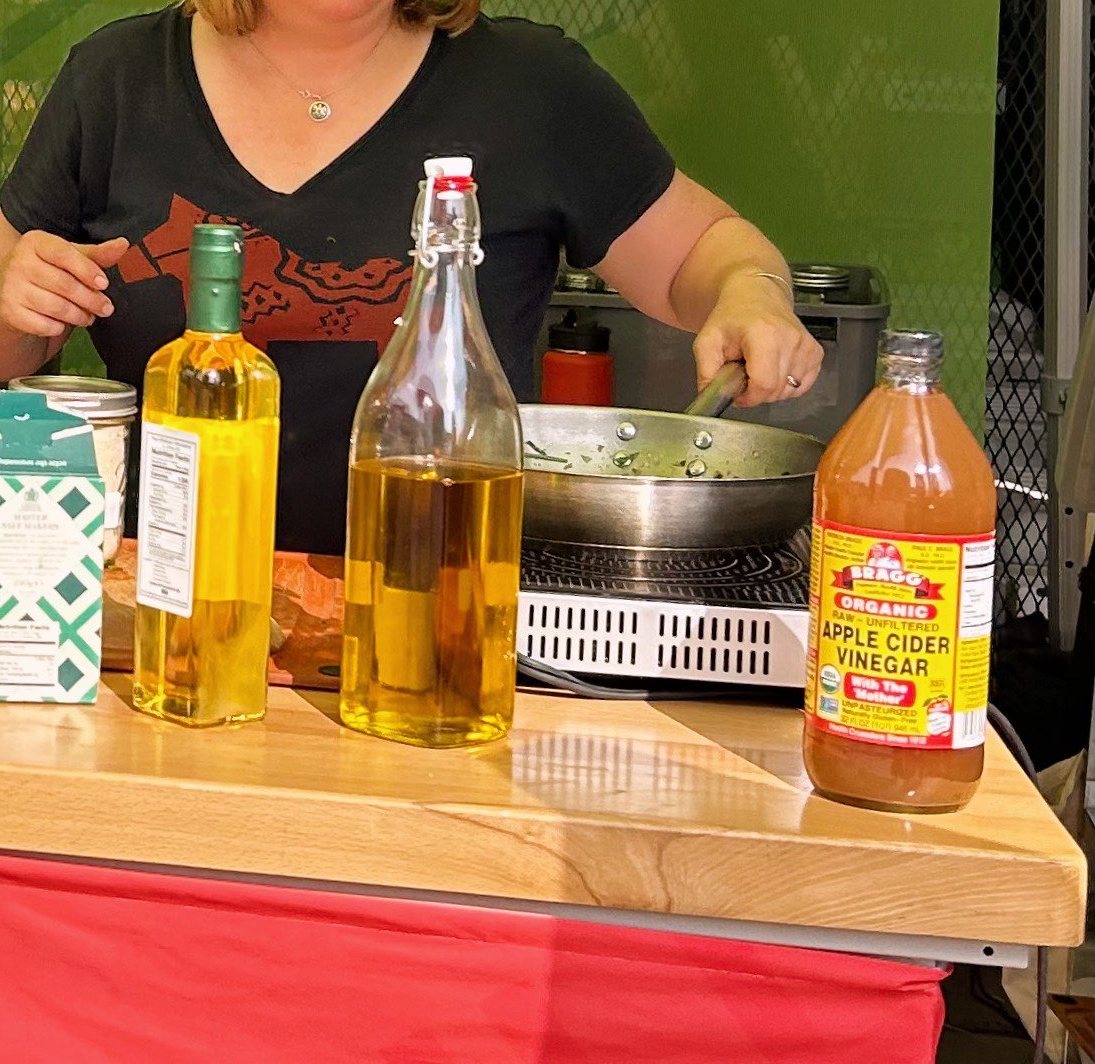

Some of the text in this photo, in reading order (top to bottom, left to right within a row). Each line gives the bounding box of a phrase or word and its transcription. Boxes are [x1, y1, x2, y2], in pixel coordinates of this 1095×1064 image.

[850, 565, 923, 586] BRAGG
[840, 595, 929, 618] ORGANIC
[832, 610, 855, 623] RAW
[866, 617, 940, 633] UNFILTERED
[823, 620, 950, 655] APPLE CIDER
[836, 646, 929, 677] VINEGAR
[850, 675, 909, 694] With The
